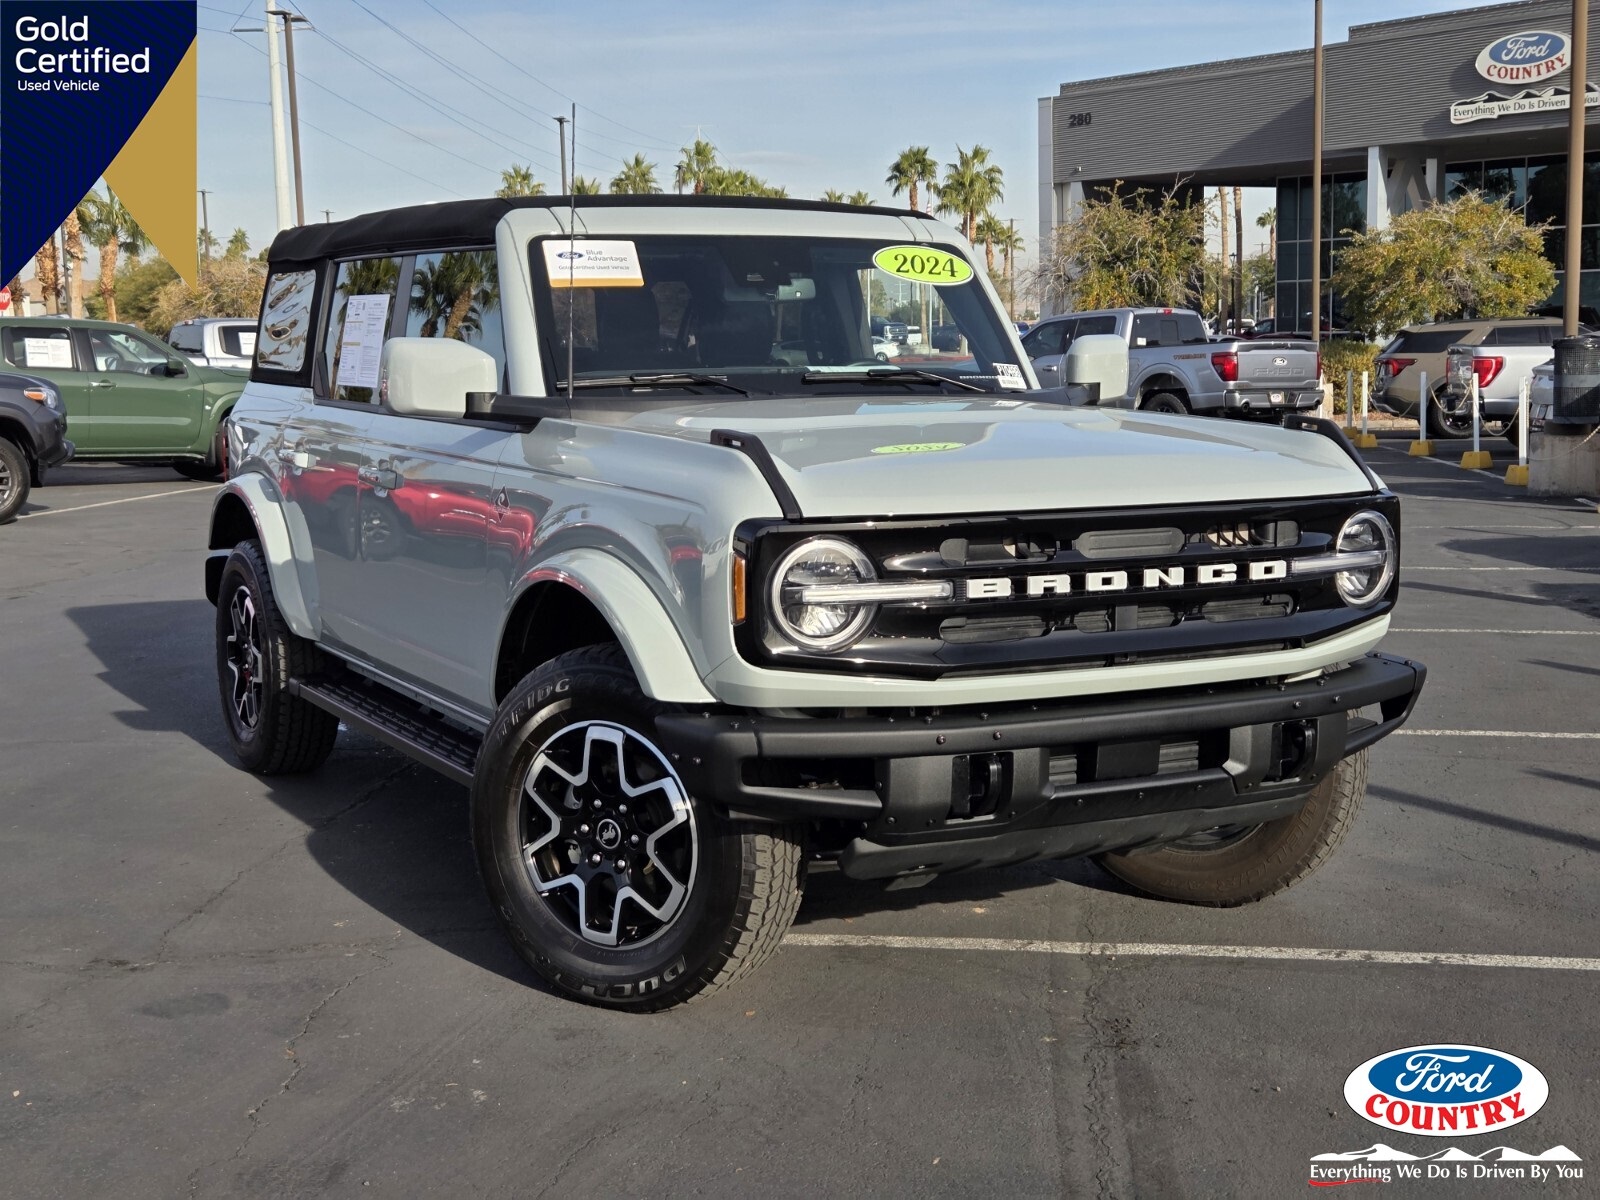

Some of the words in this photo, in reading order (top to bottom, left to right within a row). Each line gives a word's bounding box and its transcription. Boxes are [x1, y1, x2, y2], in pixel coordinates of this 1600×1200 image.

[1501, 36, 1551, 61] Ford
[1486, 53, 1567, 80] COUNTRY
[1068, 112, 1092, 128] 280
[1453, 104, 1496, 118] Everything
[1497, 103, 1511, 112] We
[1513, 102, 1526, 111] Do
[1528, 101, 1535, 109] Is
[1537, 98, 1566, 108] Driven
[587, 255, 628, 263] Advantage
[893, 253, 959, 278] 2024
[966, 559, 1288, 600] BRONCO
